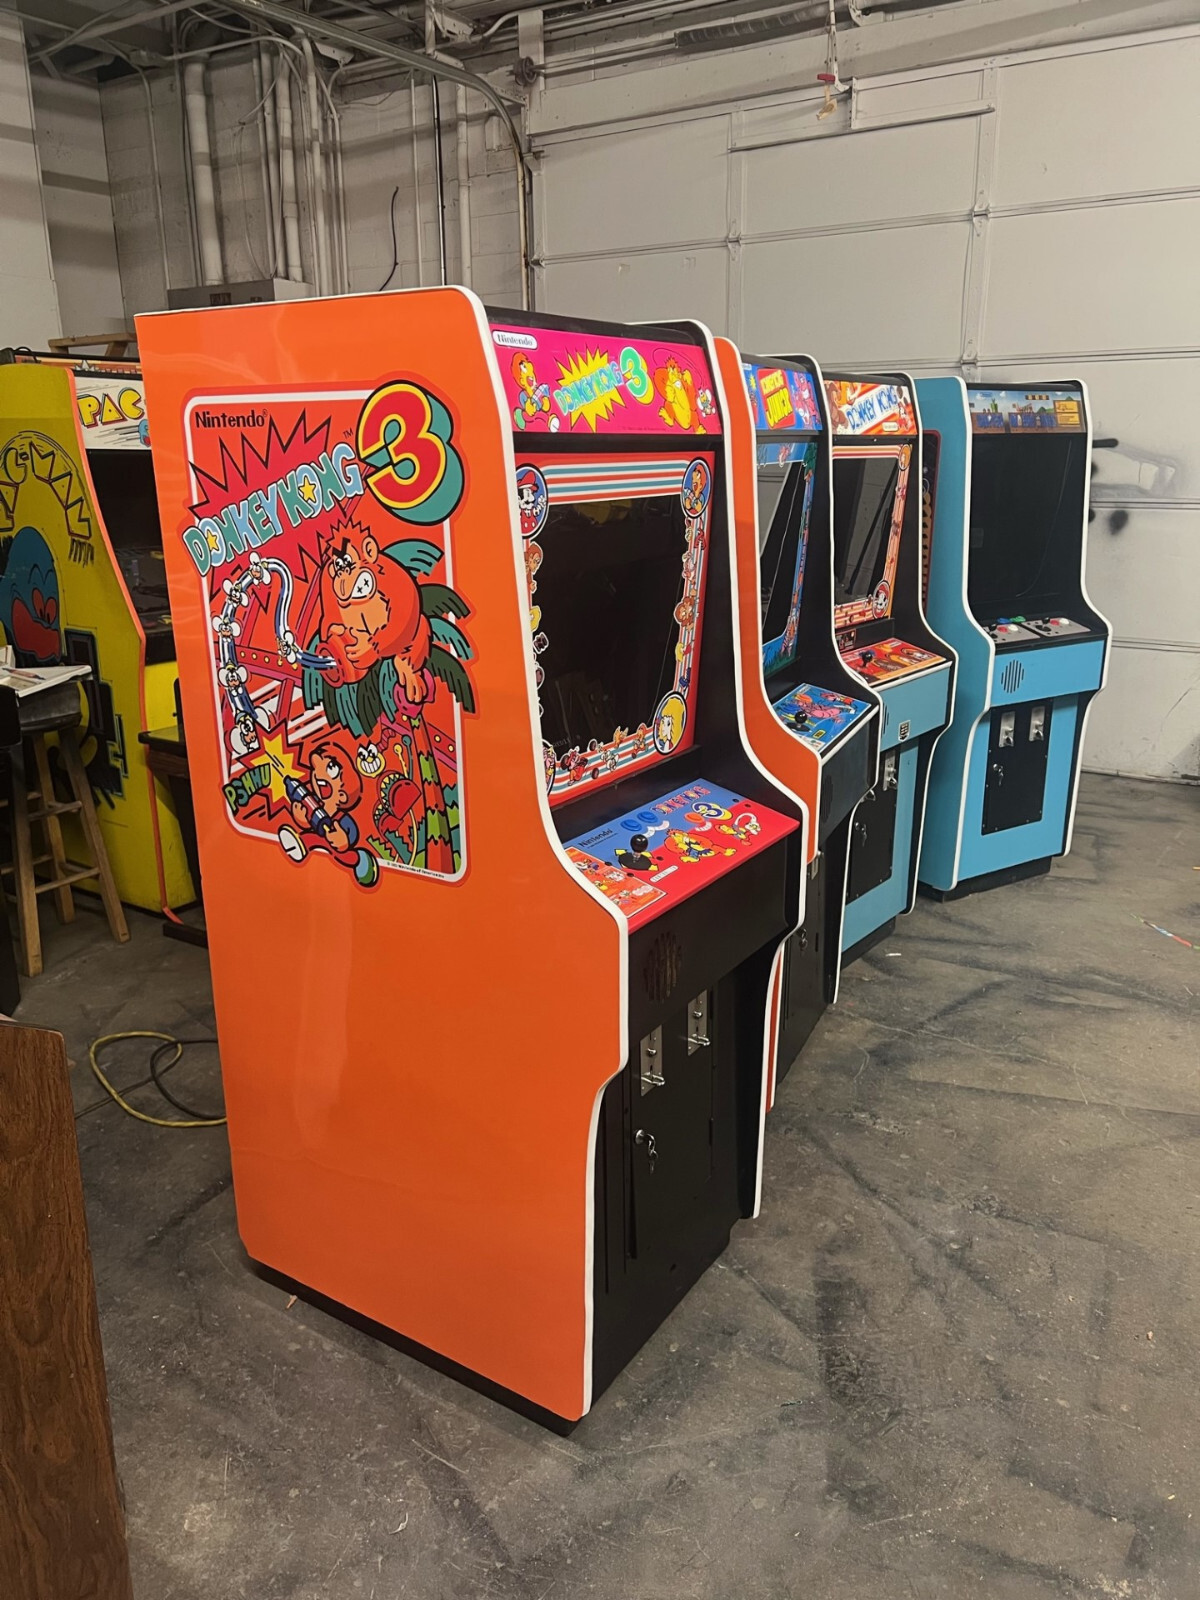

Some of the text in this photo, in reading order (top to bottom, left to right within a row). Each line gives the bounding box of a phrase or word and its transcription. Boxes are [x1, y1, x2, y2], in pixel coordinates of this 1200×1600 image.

[553, 346, 655, 416] DONKEY KONG 3
[182, 484, 284, 577] DONKEY
[277, 442, 365, 527] KONG
[355, 379, 463, 525] 3
[692, 802, 729, 819] 3
